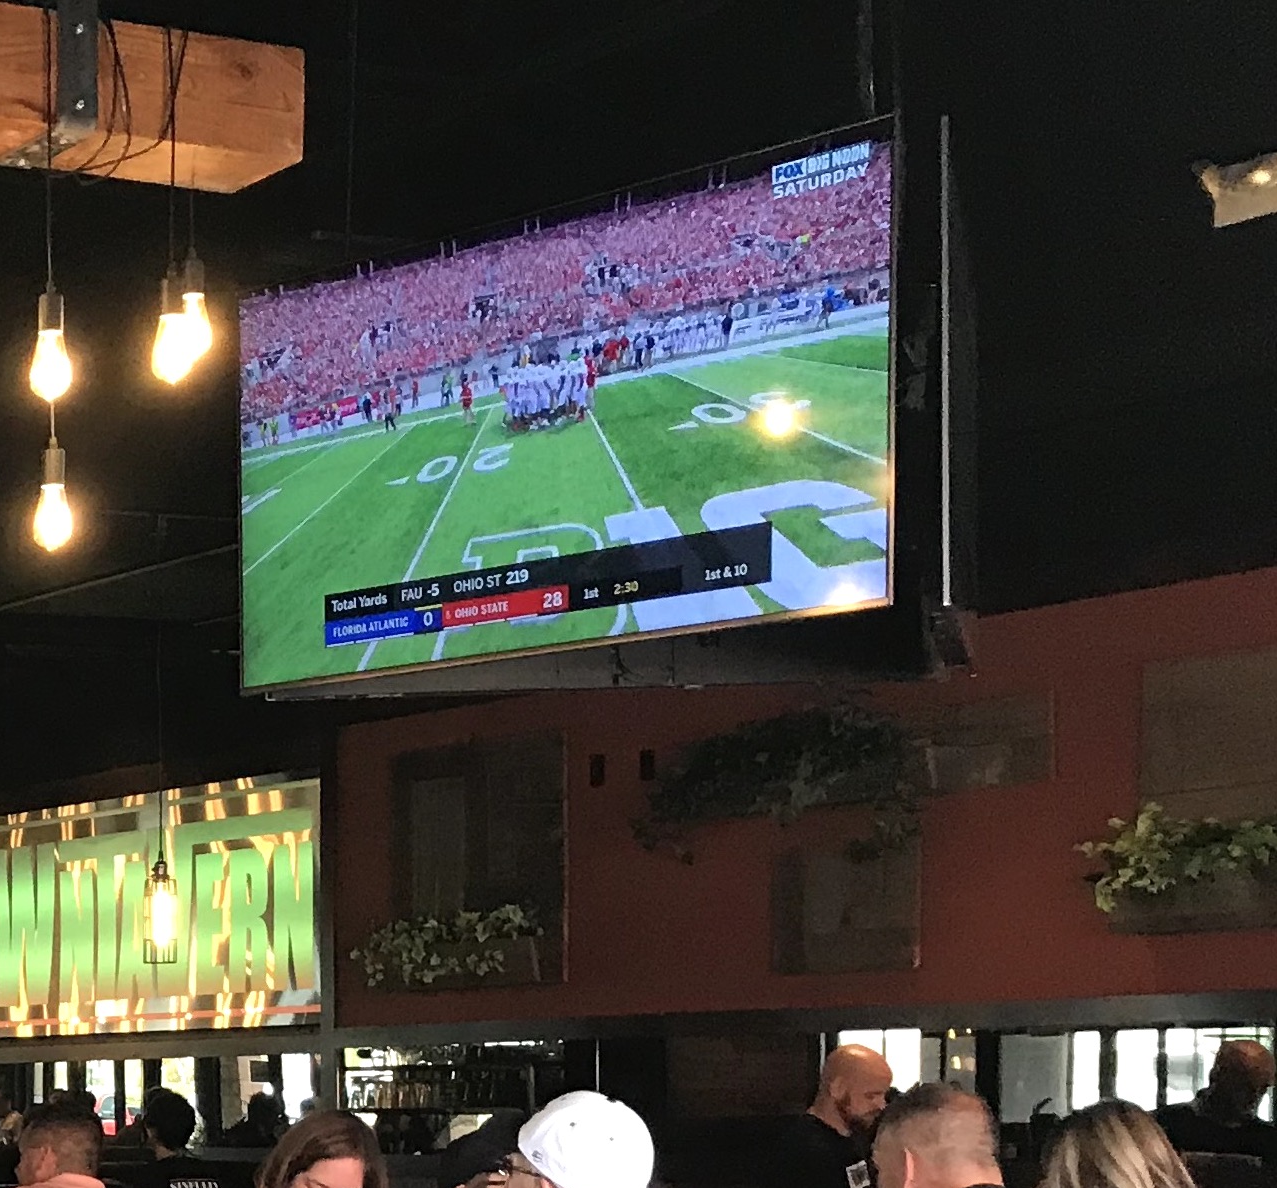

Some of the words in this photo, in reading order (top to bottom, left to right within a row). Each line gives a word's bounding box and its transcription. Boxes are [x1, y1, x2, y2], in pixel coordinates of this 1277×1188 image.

[775, 162, 804, 181] FOX
[807, 152, 830, 174] BIG
[831, 141, 870, 168] NOON
[773, 161, 870, 200] SATURDAY
[705, 568, 721, 581] 1st
[723, 566, 733, 578] &
[734, 563, 748, 577] 10
[331, 597, 357, 612] Total
[359, 592, 388, 607] Yards
[401, 587, 423, 602] FAU
[427, 583, 440, 597] -5
[453, 577, 484, 593] OHIO
[486, 574, 502, 588] ST
[506, 568, 529, 585] 219
[583, 588, 599, 600] 1st
[614, 580, 639, 595] 2:30
[454, 605, 479, 619] OHIO
[480, 601, 509, 615] STATE
[543, 592, 563, 609] 28
[333, 621, 367, 638] FLORIDA
[368, 616, 409, 633] ATLANTIC
[423, 612, 433, 627] 0
